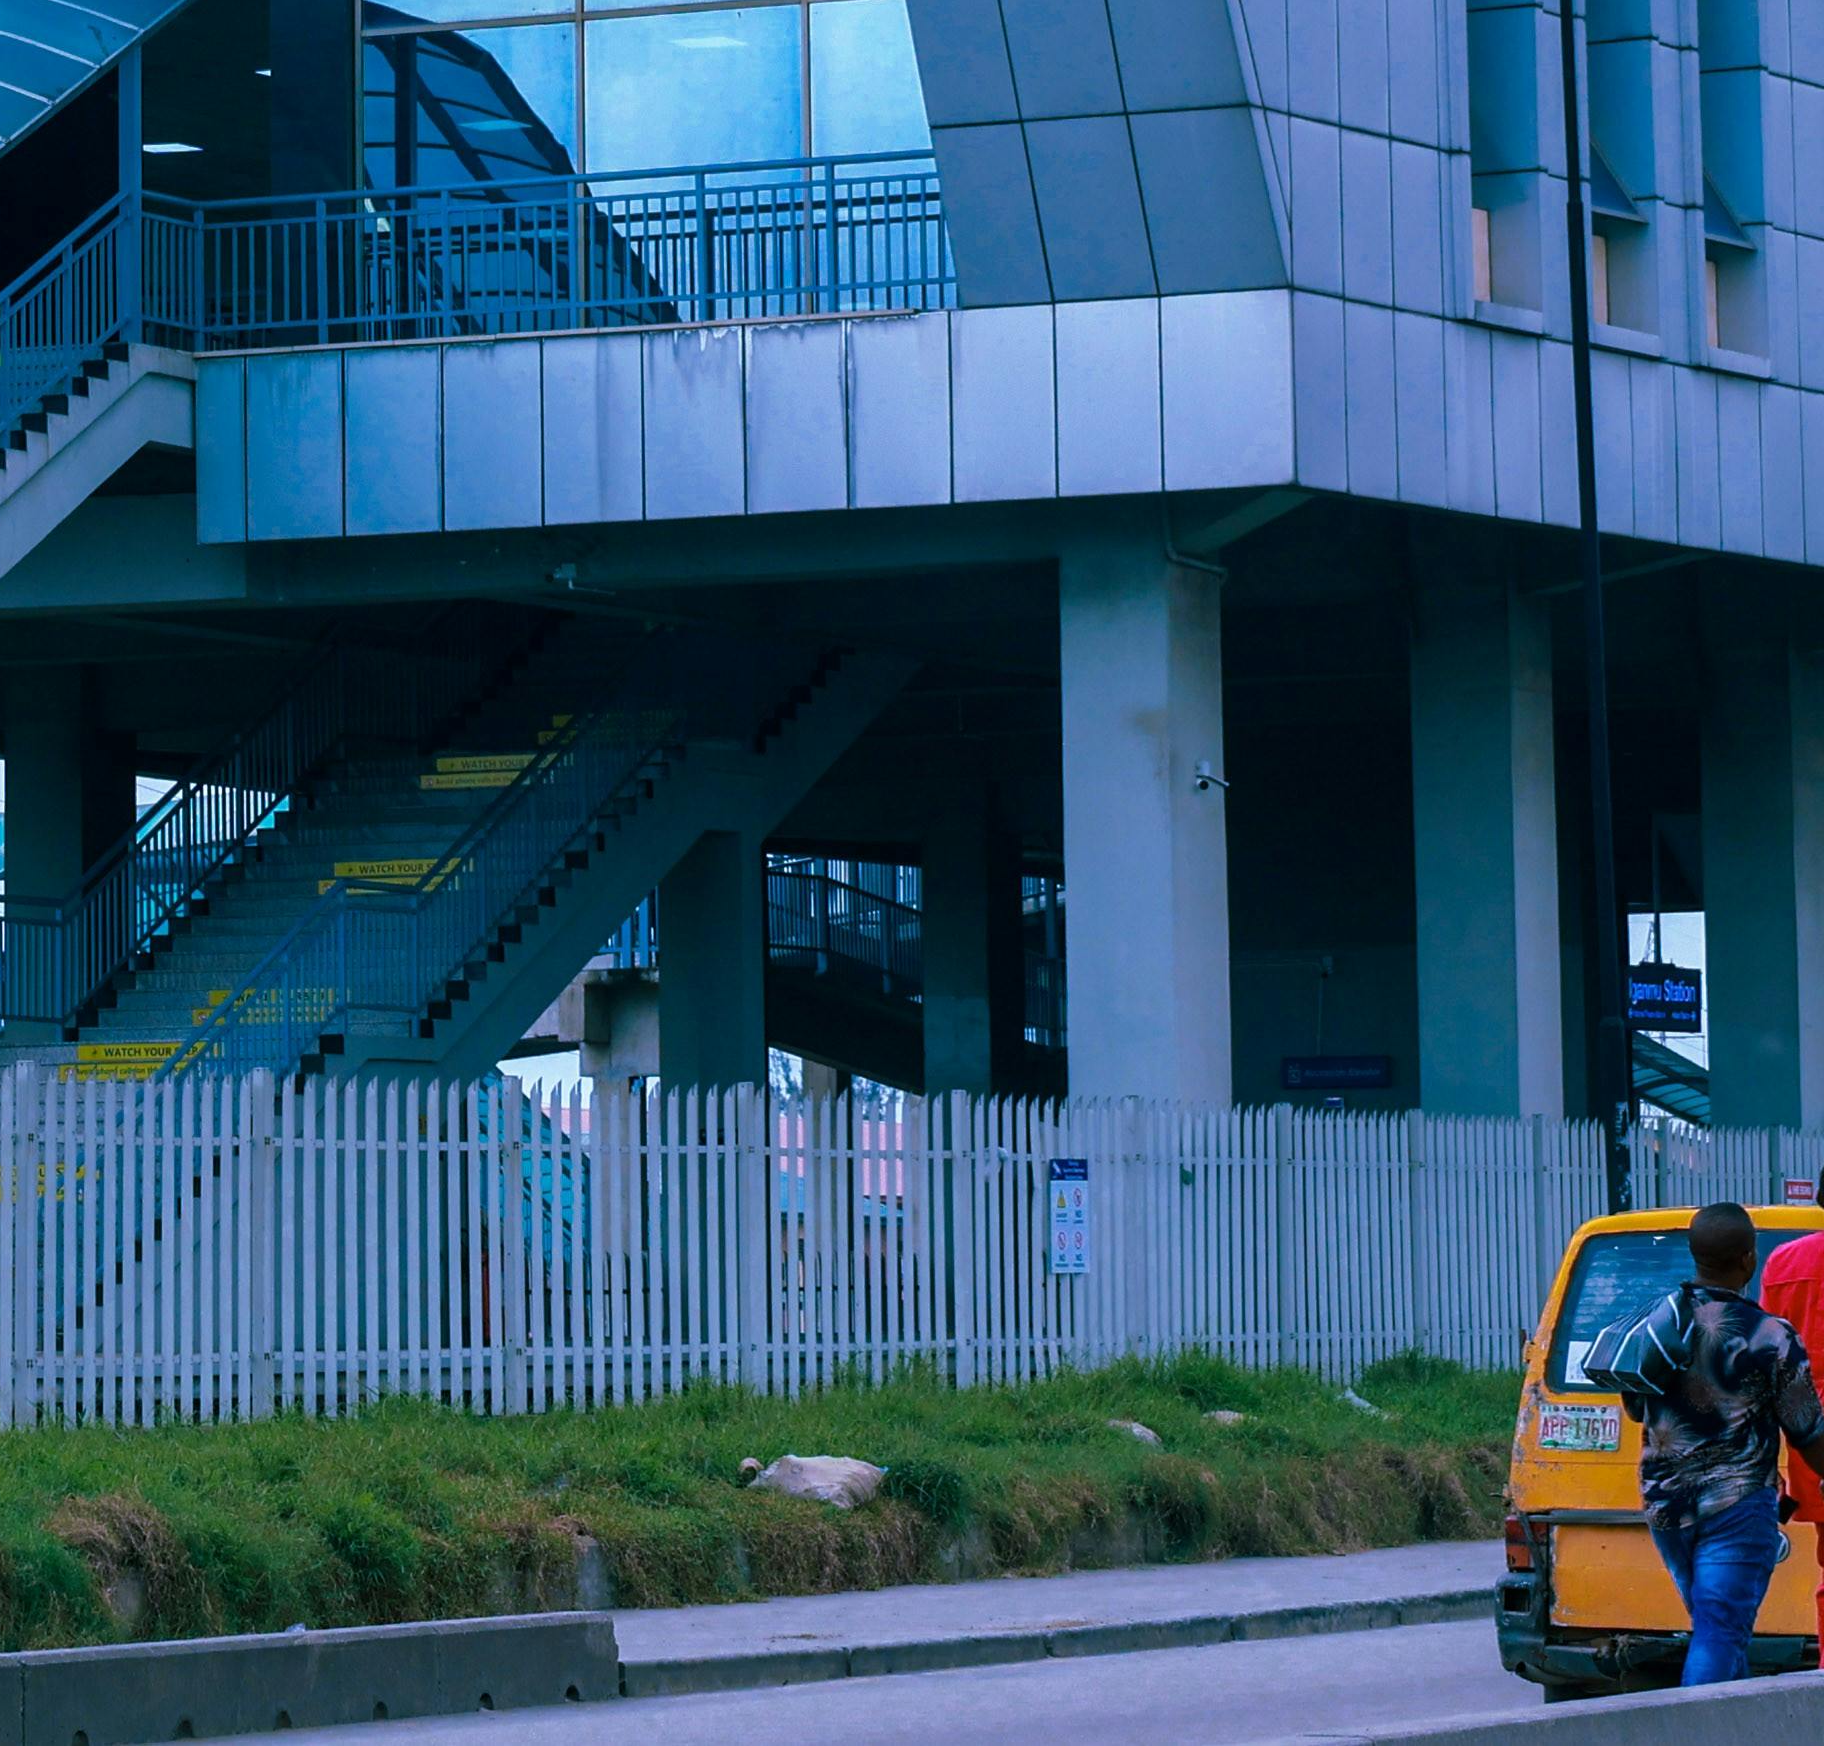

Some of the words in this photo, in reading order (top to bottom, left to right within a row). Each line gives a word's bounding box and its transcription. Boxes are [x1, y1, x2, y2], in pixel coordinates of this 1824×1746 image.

[460, 757, 496, 769] WATCH
[359, 864, 395, 874] WATCH
[396, 863, 425, 873] YOUR
[1664, 979, 1696, 1003] Station
[104, 1047, 141, 1057] WATCH
[142, 1046, 172, 1056] YOUR
